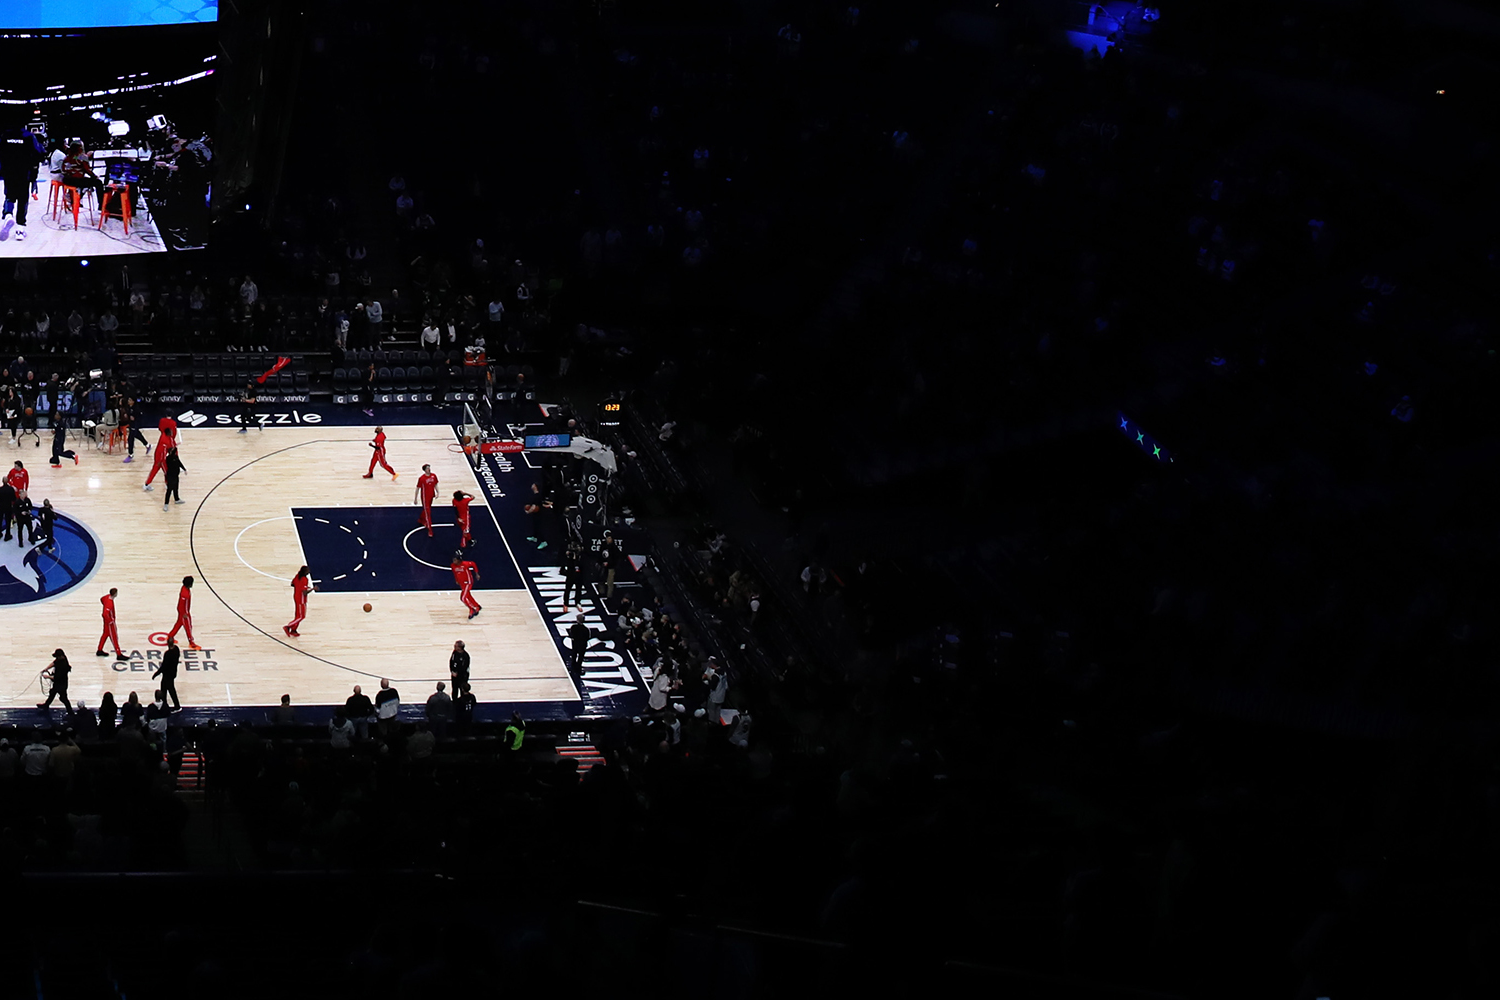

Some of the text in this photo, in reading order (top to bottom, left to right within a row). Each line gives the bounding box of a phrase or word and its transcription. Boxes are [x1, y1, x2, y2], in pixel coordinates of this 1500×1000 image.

[196, 395, 219, 403] xfinity
[283, 394, 306, 403] xfinity
[397, 394, 403, 402] G
[411, 394, 418, 402] G
[496, 392, 503, 400] G
[525, 392, 532, 400] G
[492, 452, 515, 473] ealth
[111, 661, 219, 671] CENER
